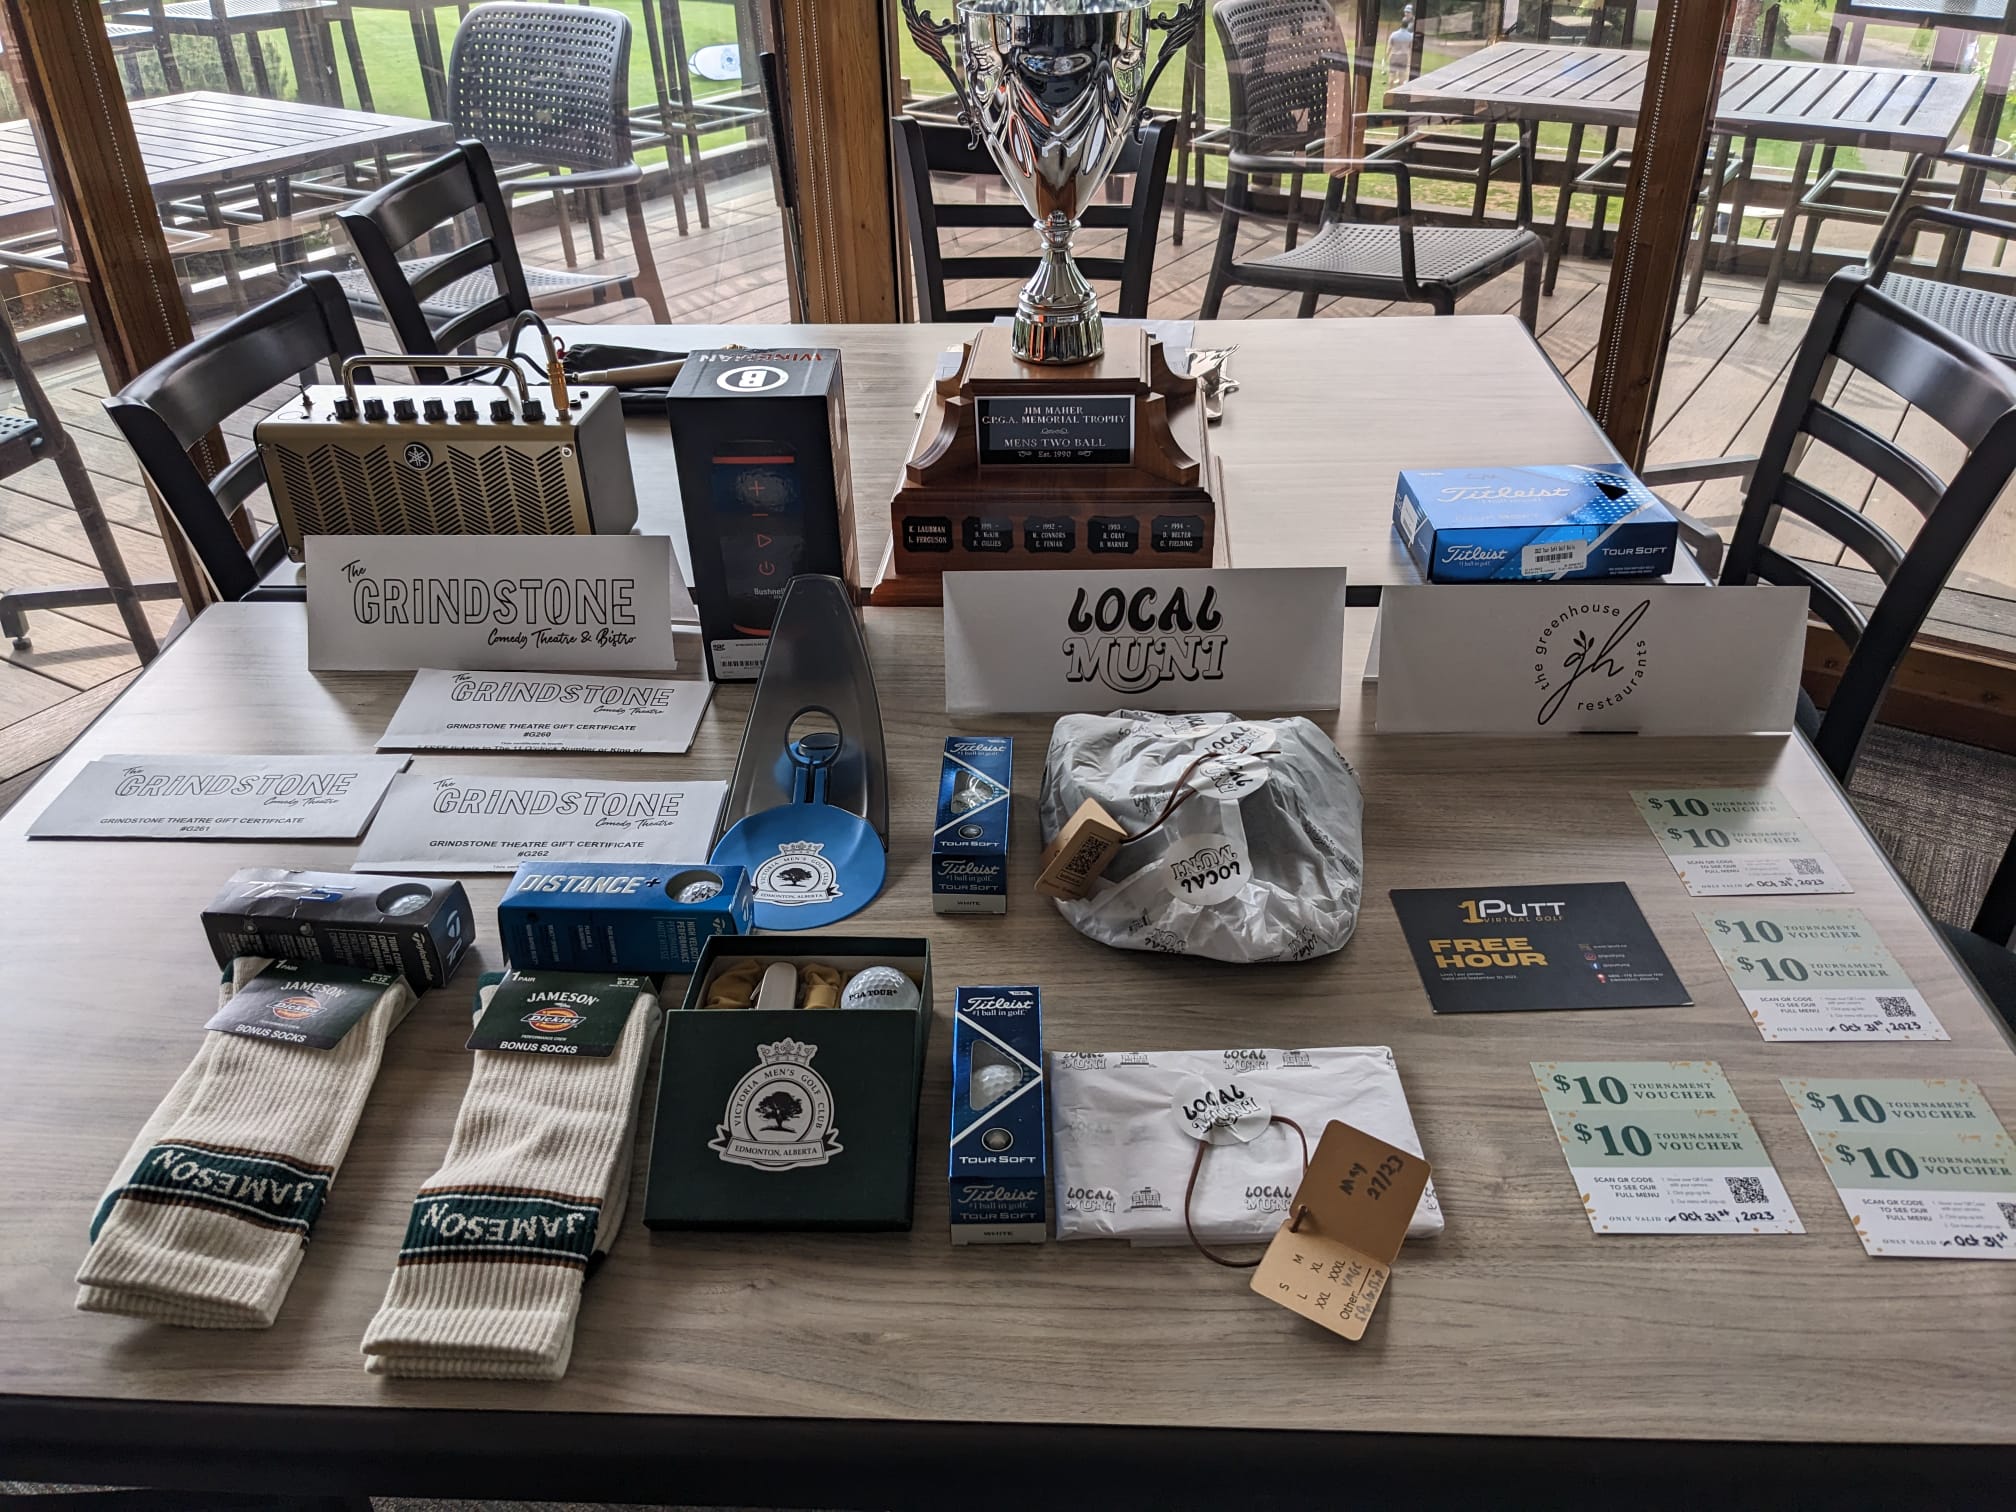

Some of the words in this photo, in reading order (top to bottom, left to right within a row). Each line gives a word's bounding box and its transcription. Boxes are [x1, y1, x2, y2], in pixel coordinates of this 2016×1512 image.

[1024, 407, 1041, 415] JIM
[1046, 407, 1084, 415] MAHER
[1022, 416, 1080, 424] MEMORIAL
[1083, 416, 1126, 424] TROPHY
[1004, 439, 1037, 447] MENS
[1041, 439, 1071, 447] TWO
[1075, 439, 1106, 447] BALL
[1438, 486, 1571, 502] Titleist
[1442, 544, 1508, 564] Titleist
[1602, 547, 1635, 556] TOUR
[1636, 546, 1668, 555] SOFT
[342, 560, 367, 583] The
[354, 579, 636, 625] GRINDSTONE
[1068, 586, 1223, 635] LOCAL
[1536, 604, 1621, 655] greenhouse
[488, 628, 528, 649] Comedy
[531, 628, 577, 649] Theatre
[581, 631, 592, 644] &
[596, 628, 637, 648] Bistro
[1062, 635, 1228, 694] MUNI
[452, 673, 472, 684] The
[1534, 664, 1550, 691] the
[1578, 640, 1647, 711] restaurants
[451, 681, 675, 707] GRINDSTONE
[509, 723, 551, 731] THEATRE
[950, 742, 1007, 753] Titleist
[122, 766, 144, 777] The
[114, 773, 359, 797] GRINDSTONE
[433, 778, 456, 790] The
[433, 788, 684, 816] GRINDSTONE
[1648, 798, 1709, 817] $10
[595, 817, 632, 830] Comedy
[635, 818, 675, 829] Theatre
[429, 840, 498, 848] GRINDSTONE
[551, 841, 576, 849] GIFT
[577, 841, 646, 849] CERTIFICATE
[1667, 828, 1730, 848] $10
[517, 850, 549, 858] #G262
[938, 860, 1000, 876] Titleist
[1182, 861, 1241, 894] LOCAL
[1714, 919, 1784, 943] $10
[1788, 931, 1861, 939] VOUCHER
[1429, 937, 1533, 953] FREE
[1434, 952, 1549, 969] HOUR
[1737, 956, 1810, 982] $10
[1814, 970, 1890, 978] VOUCHER
[281, 981, 347, 999] JAMESON
[849, 992, 867, 1001] PGA
[527, 992, 600, 1006] JAMESON
[963, 996, 1034, 1012] Titleist
[530, 1015, 578, 1024] Dickies
[236, 1023, 270, 1038] BONUS
[271, 1030, 307, 1043] SOCKS
[500, 1041, 539, 1052] BONUS
[541, 1044, 578, 1054] SOCKS
[1223, 1050, 1267, 1061] LOCAL
[1553, 1074, 1628, 1105] $10
[1634, 1091, 1716, 1100] VOUCHER
[735, 1080, 759, 1127] VICTORIA
[764, 1069, 795, 1079] MEN'S
[802, 1075, 822, 1095] GOLF
[816, 1102, 825, 1129] CLUB
[1183, 1084, 1246, 1121] LOCAL
[1806, 1091, 1886, 1124] $10
[1886, 1101, 1971, 1109] TOURNAMENT
[1891, 1110, 1977, 1119] VOUCHER
[1574, 1123, 1653, 1157] $10
[1654, 1132, 1739, 1140] TOURNAMENT
[1658, 1142, 1744, 1151] VOUCHER
[783, 1147, 818, 1156] ALBERTA
[959, 1156, 997, 1165] TOUR
[999, 1156, 1036, 1164] SOFT
[1836, 1144, 1920, 1180] $10
[1920, 1156, 2006, 1165] TOURNAMENT
[152, 1148, 316, 1205] JAMESON
[1925, 1165, 2012, 1176] VOUCHER
[1339, 1163, 1368, 1196] May
[958, 1184, 1038, 1204] Titleist
[1067, 1187, 1114, 1201] LOCAL
[1244, 1186, 1293, 1199] LOCAL
[1065, 1198, 1116, 1214] MUNI
[421, 1202, 586, 1244] JAMESON
[1277, 1282, 1289, 1291] S
[1292, 1254, 1304, 1265] M
[1296, 1293, 1307, 1301] L
[1309, 1260, 1322, 1274] XL
[1314, 1291, 1331, 1309] XXL
[1327, 1260, 1345, 1282] XXXL
